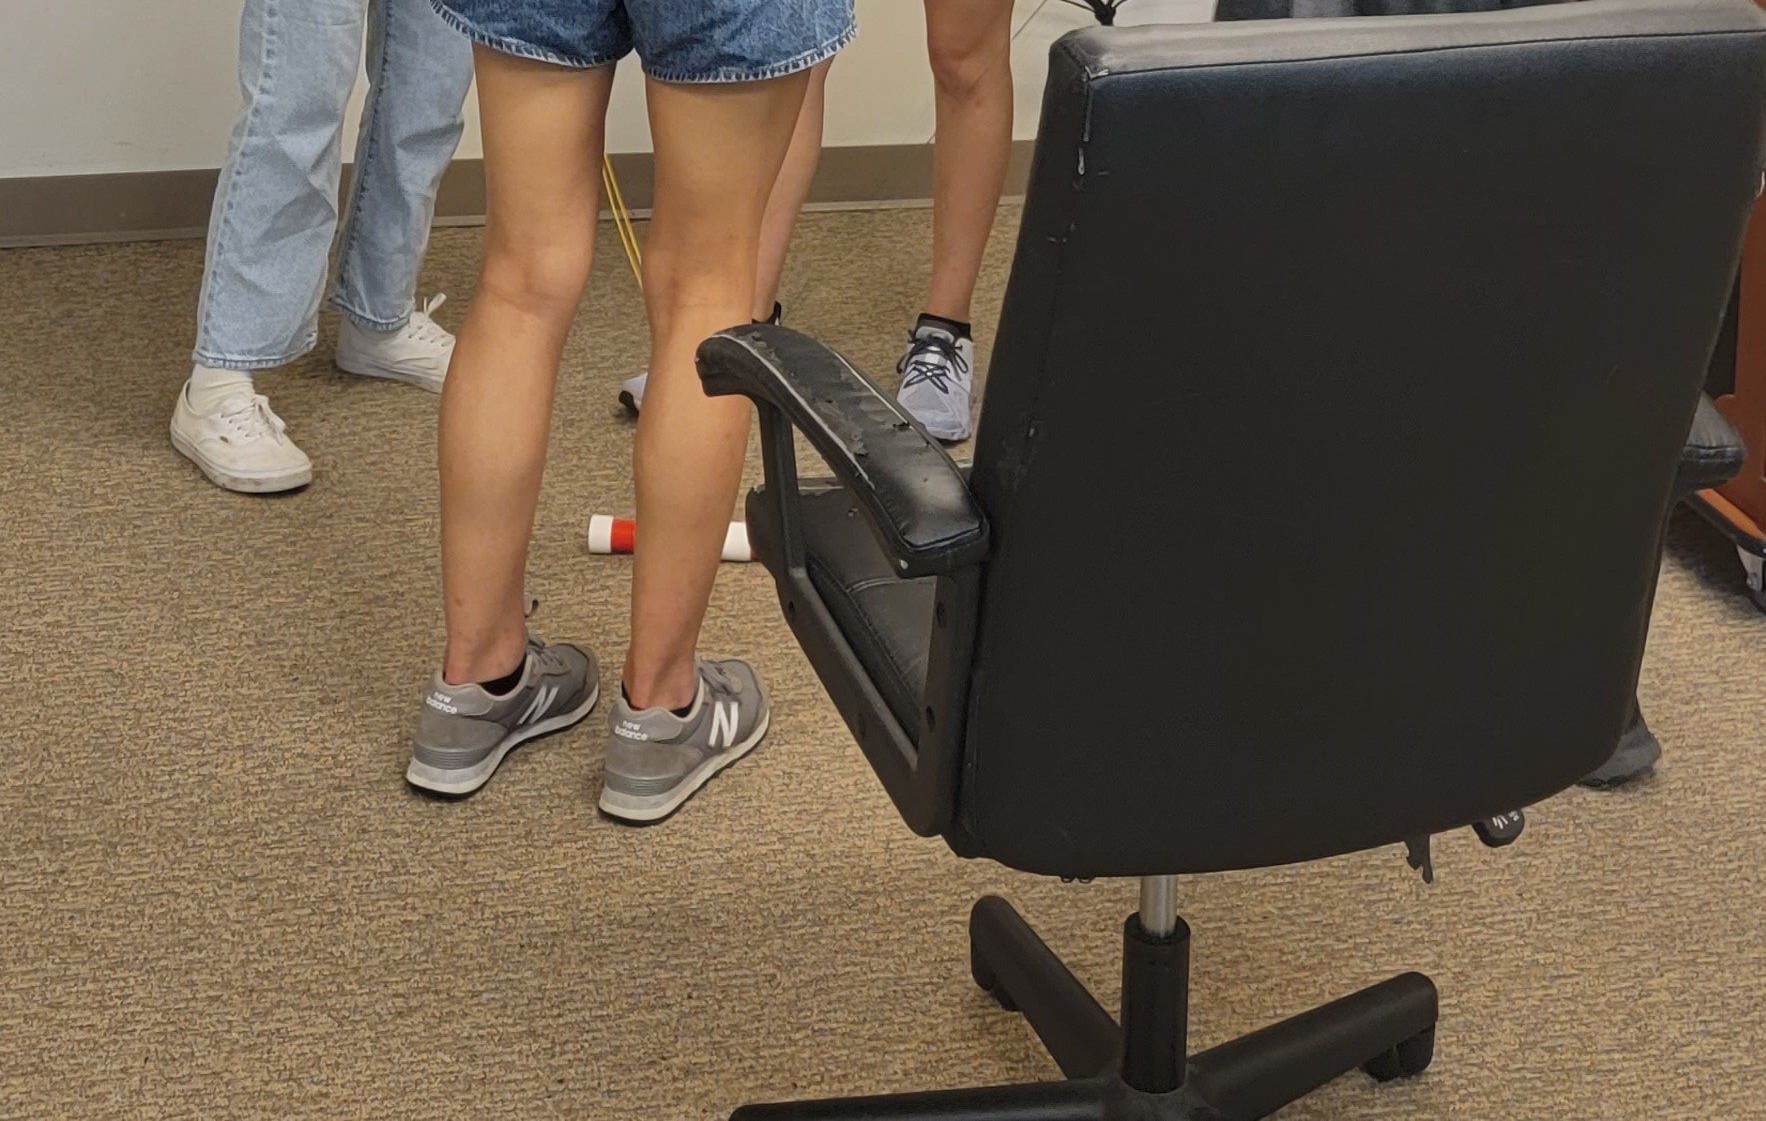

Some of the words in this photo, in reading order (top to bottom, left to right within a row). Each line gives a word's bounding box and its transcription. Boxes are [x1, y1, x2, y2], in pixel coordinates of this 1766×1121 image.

[426, 695, 458, 715] balance
[433, 691, 452, 704] new
[517, 685, 560, 725] N
[614, 724, 649, 741] balance
[622, 720, 641, 731] new
[708, 701, 739, 748] N
